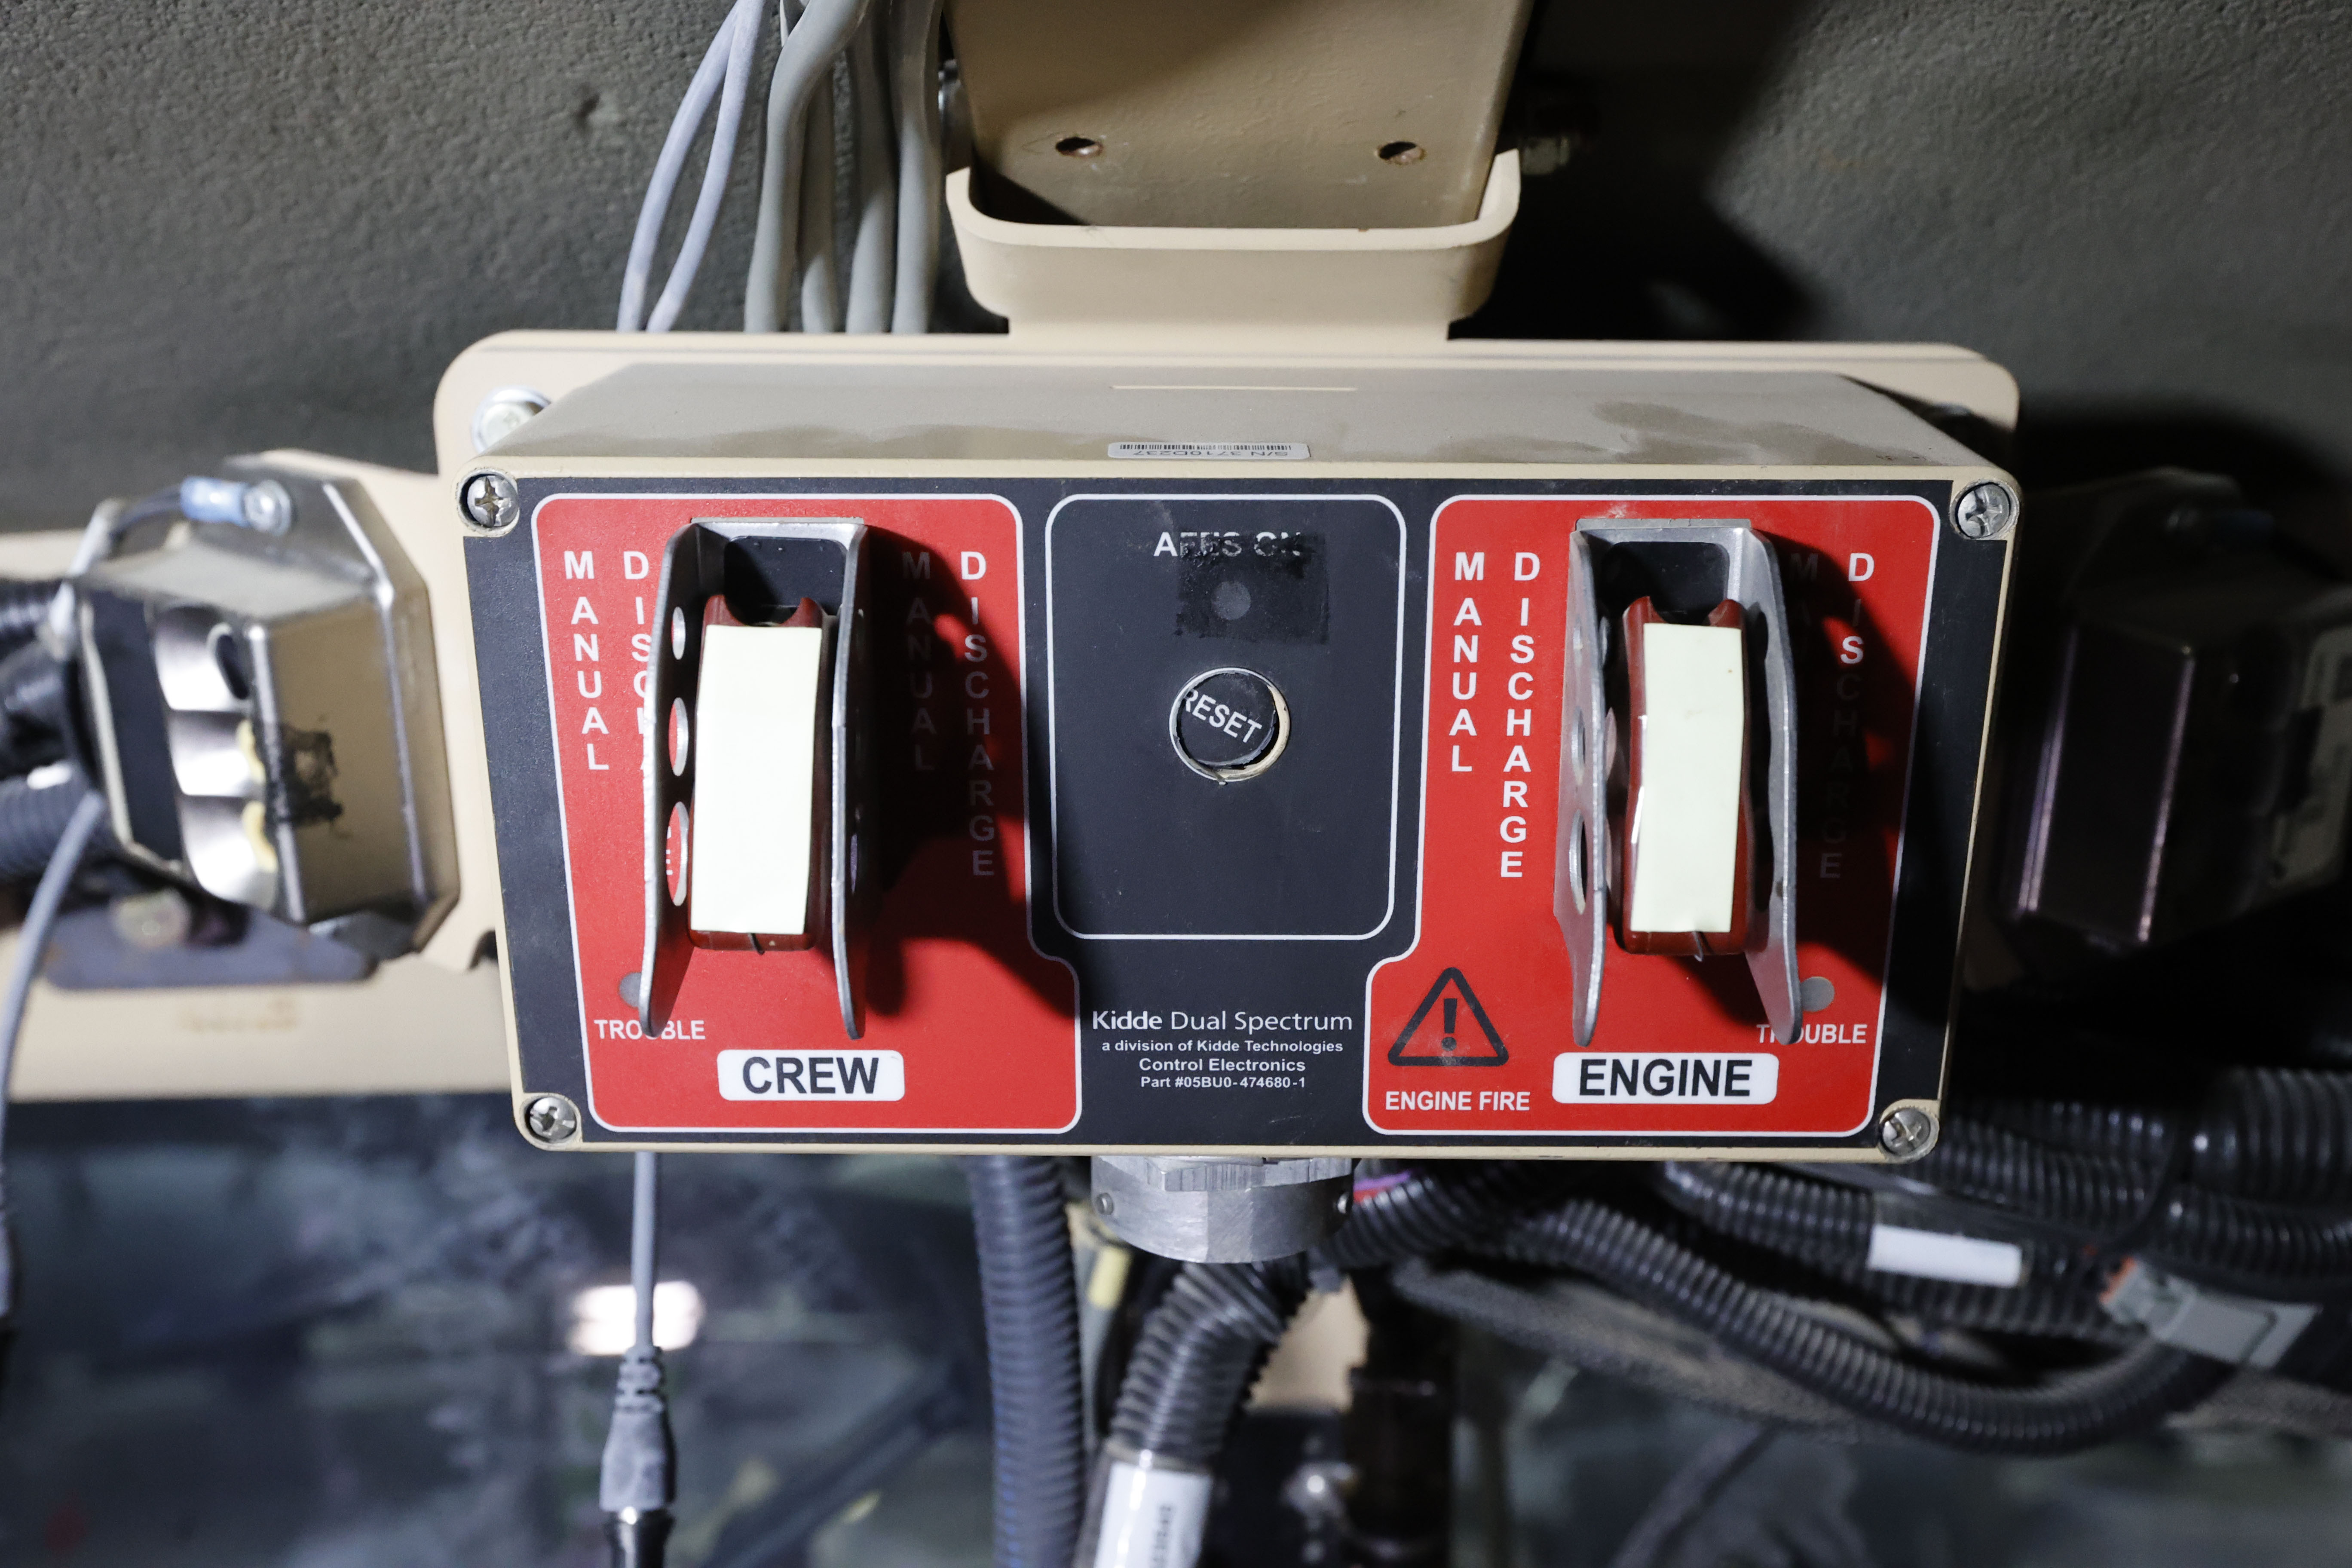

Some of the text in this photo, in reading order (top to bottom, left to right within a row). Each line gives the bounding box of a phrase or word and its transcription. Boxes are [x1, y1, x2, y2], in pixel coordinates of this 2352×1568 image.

[564, 551, 609, 771] MANUAL
[901, 551, 937, 771] MANUAL
[1449, 551, 1485, 772] MANUAL
[961, 551, 995, 877] DISCHARGE
[1185, 689, 1262, 743] RESET
[1500, 552, 1540, 878] DISCHARGE
[594, 1020, 706, 1040] TROBLE
[1093, 1011, 1352, 1035] Kidde Dual Spectrum
[1756, 1024, 1868, 1044] TUBLE
[1102, 1040, 1343, 1054] a division of Kidde Technologies
[1139, 1058, 1306, 1072] Control Electronics
[743, 1057, 879, 1094] CREW
[1141, 1076, 1171, 1087] Part
[1579, 1058, 1752, 1097] ENGINE
[1385, 1091, 1531, 1111] ENGINE FIRE
